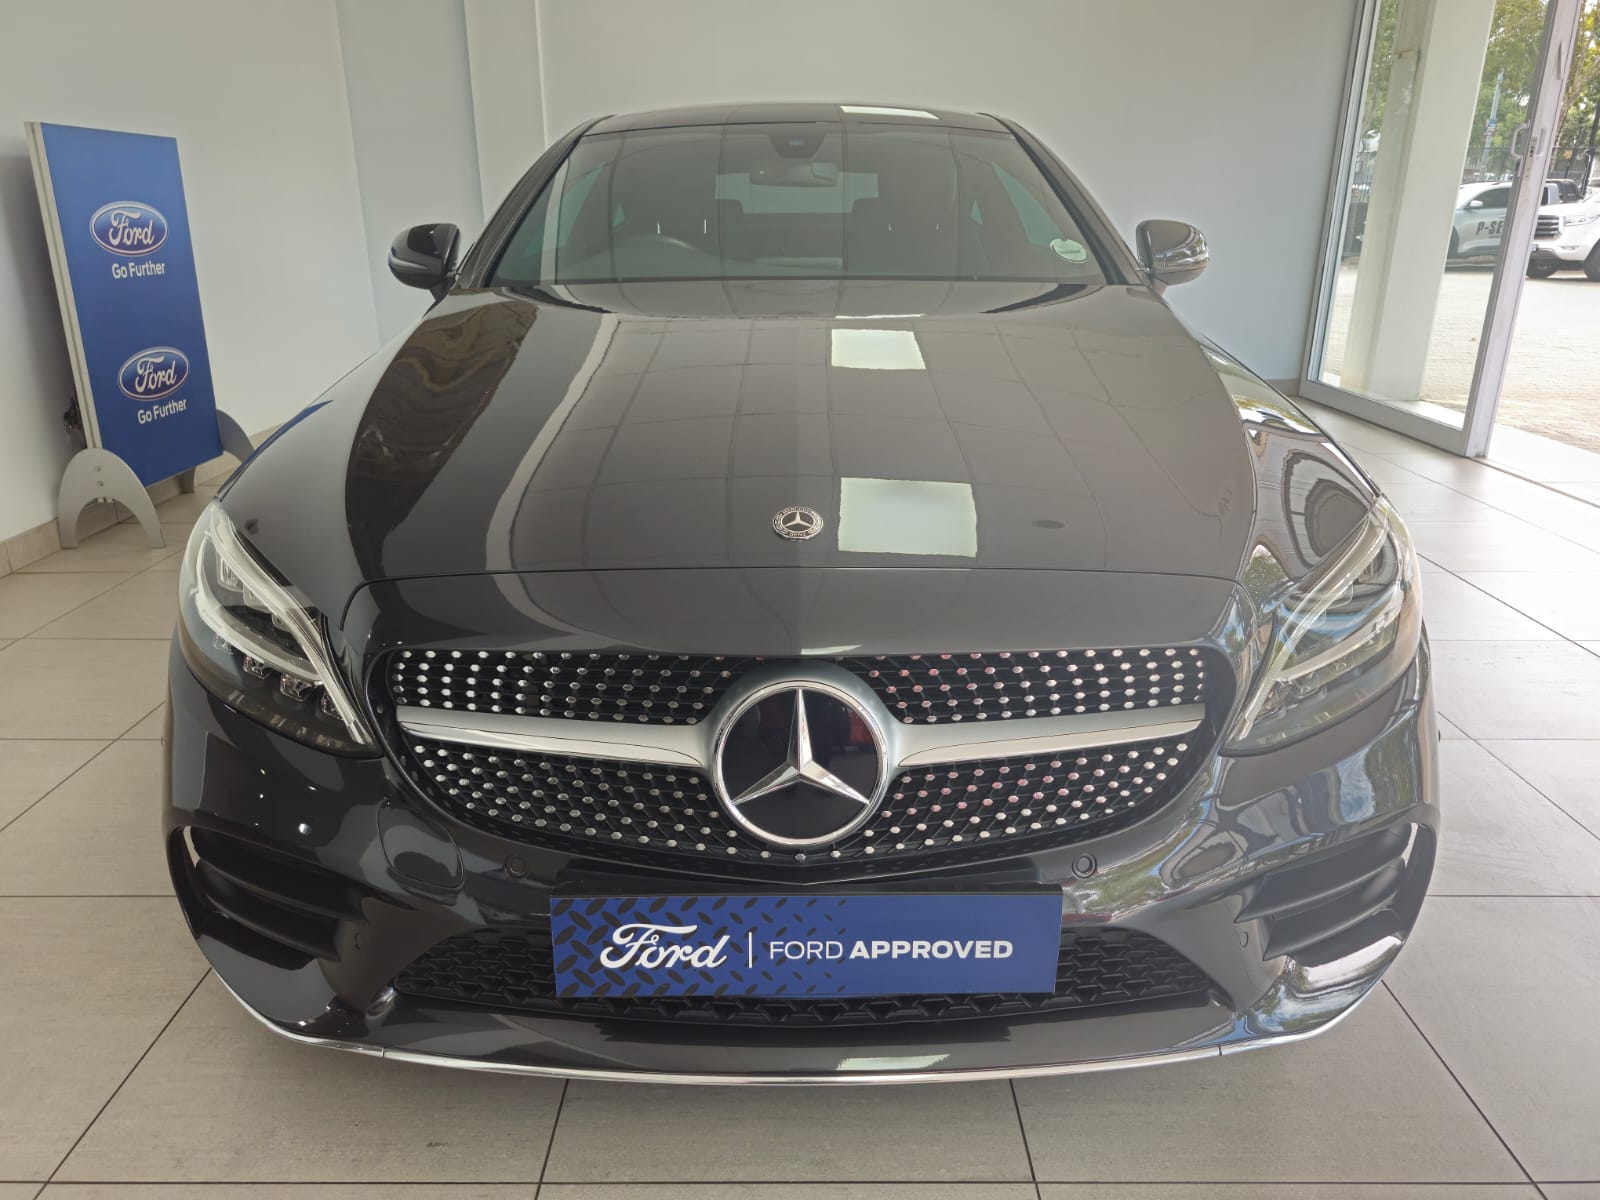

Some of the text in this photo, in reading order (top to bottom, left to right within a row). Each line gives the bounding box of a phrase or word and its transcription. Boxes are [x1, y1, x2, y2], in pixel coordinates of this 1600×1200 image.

[108, 209, 155, 246] Ford
[111, 262, 166, 279] Go Further
[135, 355, 178, 393] Ford
[137, 398, 188, 424] Go Further
[599, 923, 1014, 970] Ford FORD APPROVED
